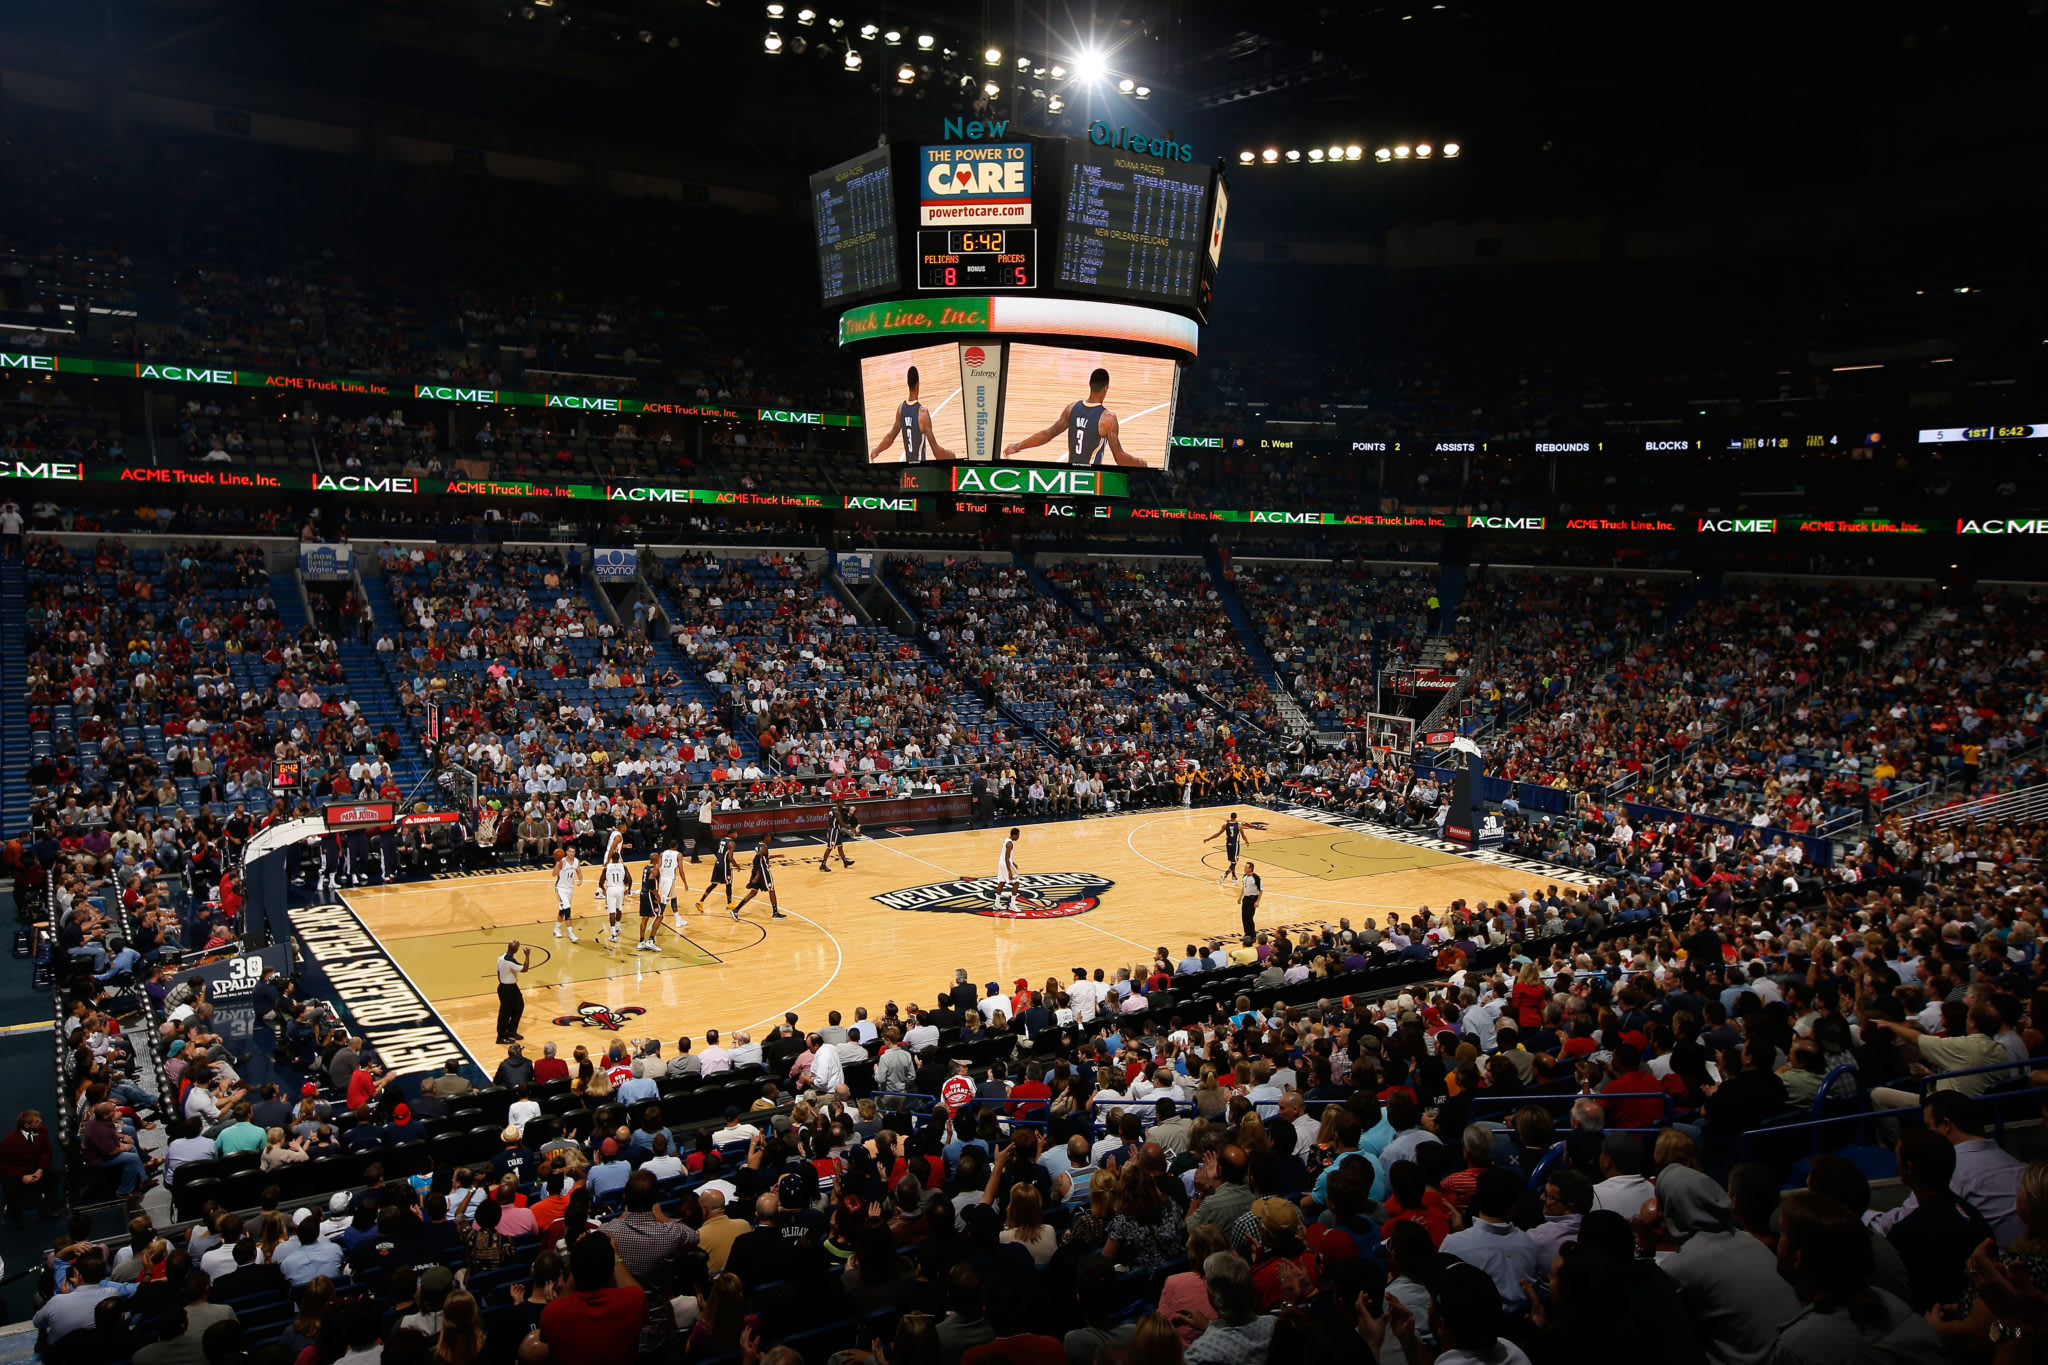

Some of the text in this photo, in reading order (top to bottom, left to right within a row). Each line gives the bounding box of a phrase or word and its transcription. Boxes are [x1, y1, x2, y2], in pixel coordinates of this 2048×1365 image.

[944, 117, 1007, 140] New
[1089, 120, 1192, 162] Orleans
[928, 148, 1024, 161] THE POWER TO
[1114, 158, 1165, 176] INDIANA PACERS
[928, 162, 1024, 195] CARE
[929, 206, 1024, 220] powertocare.com
[963, 233, 1002, 251] 6:42
[1094, 228, 1169, 246] NEW ORLEANS PELICANS
[924, 254, 1025, 264] PELICANS PACERS
[945, 266, 1026, 286] 8 5
[846, 310, 878, 336] Truck
[882, 308, 932, 328] Line,
[940, 306, 986, 325] Inc.
[141, 365, 233, 385] ACME
[971, 369, 996, 378] Entergy
[265, 376, 390, 395] ACME Truck Line, Inc.
[418, 386, 494, 403] ACME
[548, 396, 618, 411] ACME
[643, 403, 738, 418] ACME Truck Line, Inc.
[760, 410, 821, 424] ACME
[976, 386, 988, 456] entergy.com
[1830, 435, 1838, 444] 4
[1937, 426, 2024, 439] 5 1ST 6:42
[1075, 430, 1084, 454] 3
[1170, 437, 1221, 448] ACME
[1261, 440, 1293, 448] D. West
[1352, 442, 1385, 451] POINTS
[1435, 443, 1487, 452] ASSISTS 1
[1536, 443, 1603, 452] REBOUNDS 1
[1646, 441, 1701, 450] BLOCKS 1
[120, 468, 281, 486] ACME Truck Line, Inc.
[317, 475, 412, 493] ACME
[904, 468, 1095, 494] Inc. ACME
[447, 482, 575, 497] ACME Truck Line, Inc.
[612, 488, 689, 503] ACME
[716, 493, 823, 506] ACME Truck Line, Inc.
[848, 497, 913, 510] ACME
[1048, 504, 1108, 518] ACE
[1131, 509, 1224, 520] ACME Truck Line, Inc.
[1253, 512, 1320, 524] ACME
[1344, 515, 1444, 526] ACME Truck Line, Inc.
[1471, 517, 1542, 529] ACME
[1566, 519, 1675, 530] ACME Truck Line, Inc.
[1701, 520, 1772, 533] ACME
[1800, 521, 1923, 532] ACME Truck Line, Inc.
[1962, 520, 2048, 534] ACME
[308, 552, 334, 560] Know.
[596, 566, 636, 574] evamor
[280, 764, 298, 773] 6:42
[278, 774, 293, 786] 0.0
[342, 812, 357, 820] PAPA
[1483, 816, 1497, 829] 30
[744, 820, 754, 829] big
[756, 818, 790, 826] discounts.
[1478, 826, 1505, 839] SPALDING
[1340, 823, 1467, 851] ORLEANS
[1456, 850, 1608, 885] PELICANS
[664, 859, 672, 868] 23
[612, 872, 620, 883] 11
[876, 886, 953, 909] NEW
[287, 904, 380, 961] PELICANS
[230, 956, 263, 979] 30
[212, 977, 260, 996] SPALD
[322, 958, 430, 1027] ORLEANS
[365, 1026, 469, 1076] NEW
